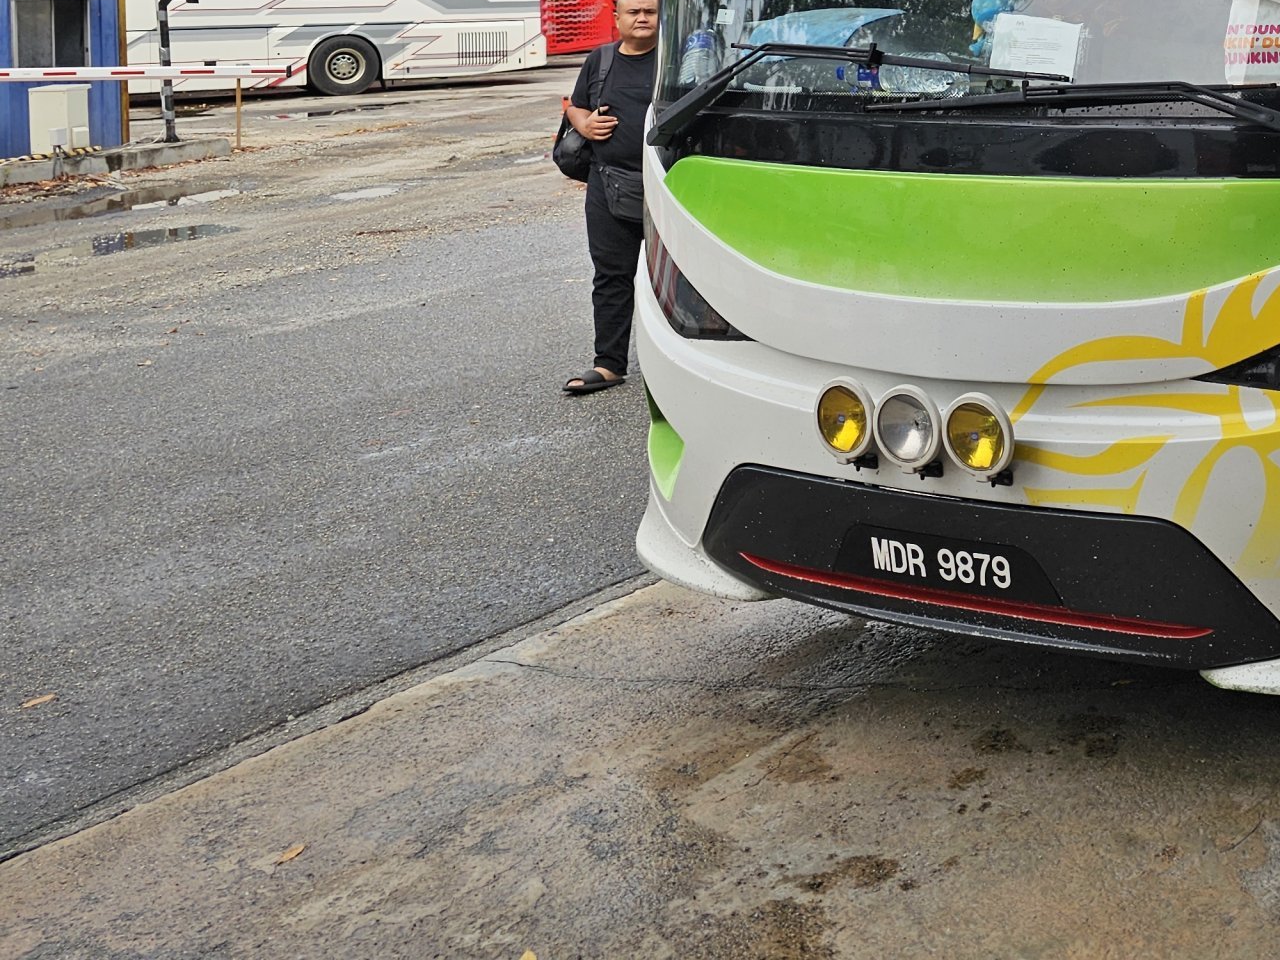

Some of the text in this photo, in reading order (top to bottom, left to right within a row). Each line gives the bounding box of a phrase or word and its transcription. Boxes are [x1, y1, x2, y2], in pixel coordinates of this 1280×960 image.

[1226, 36, 1260, 49] KIN'
[870, 536, 1012, 589] MDR 9879
